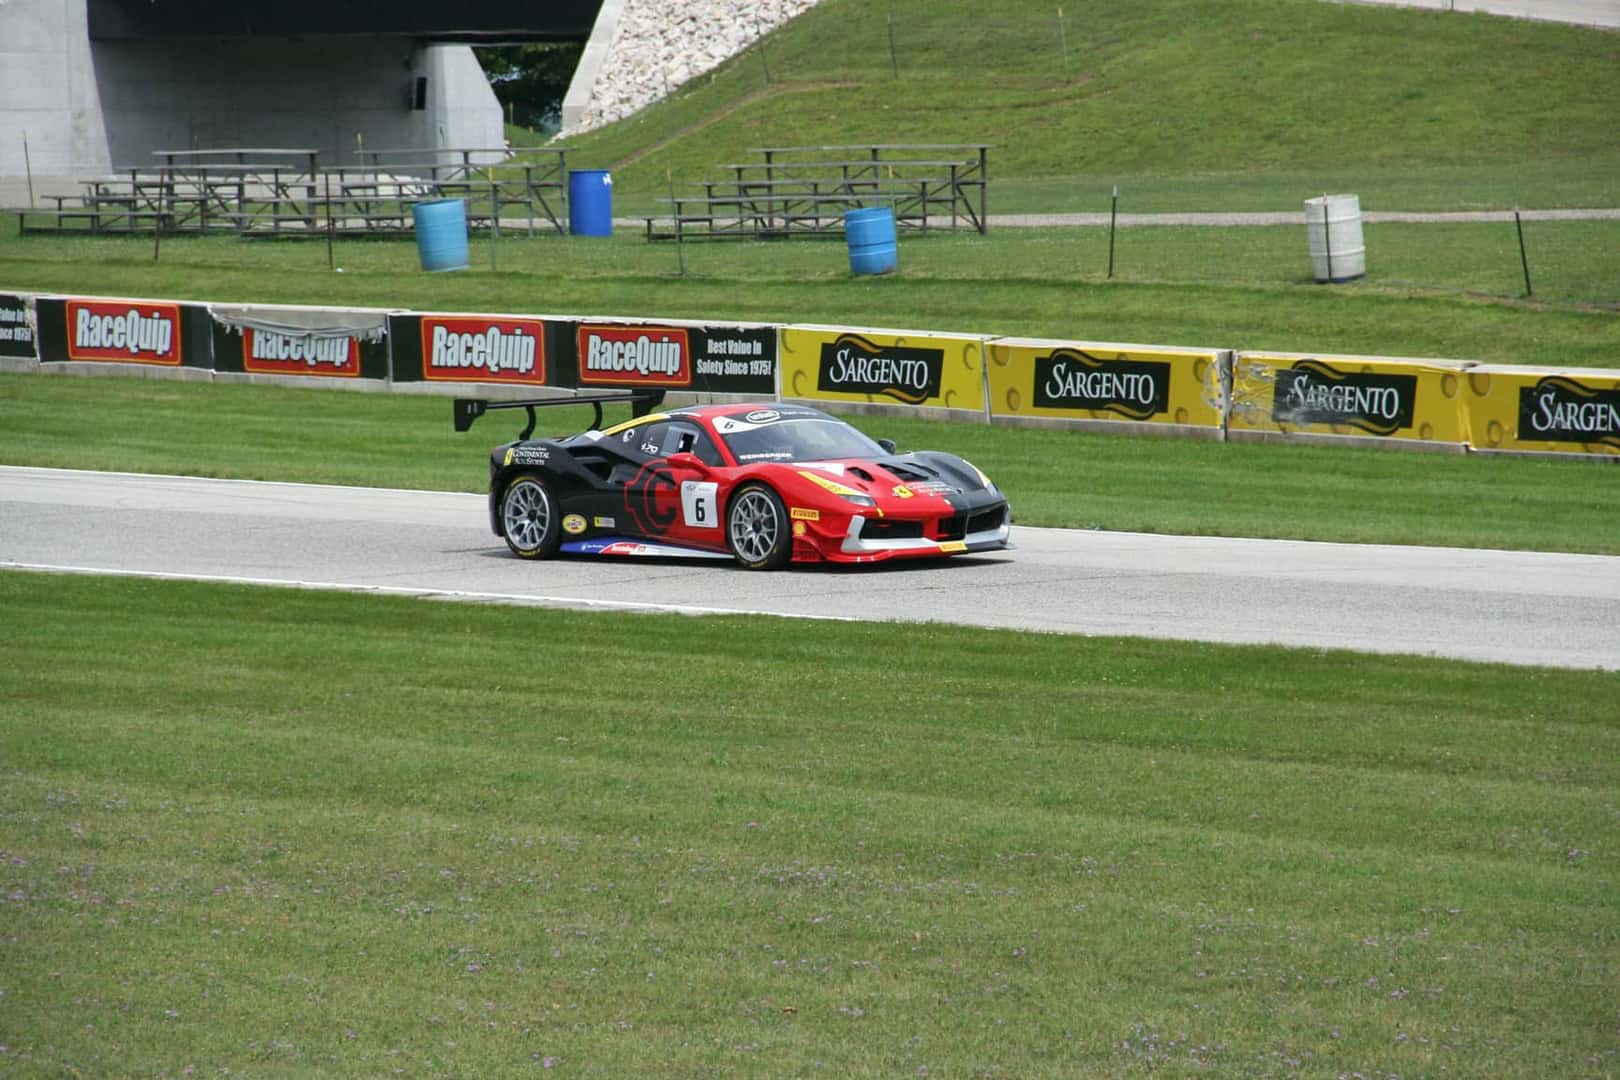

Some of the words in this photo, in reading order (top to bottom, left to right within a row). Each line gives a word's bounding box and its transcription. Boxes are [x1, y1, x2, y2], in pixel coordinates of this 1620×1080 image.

[76, 308, 171, 355] RaceQuip
[432, 326, 535, 373] RaceQuip
[707, 339, 727, 354] Best
[728, 340, 752, 355] Value
[587, 335, 681, 375] RaceQuip
[697, 359, 723, 375] Safety
[724, 360, 749, 375] Since
[750, 360, 772, 375] 1975!
[829, 348, 928, 389] SARGENTO
[1045, 362, 1155, 404] SARGENTO
[1286, 375, 1399, 419] SARGENTO
[695, 497, 706, 522] 6
